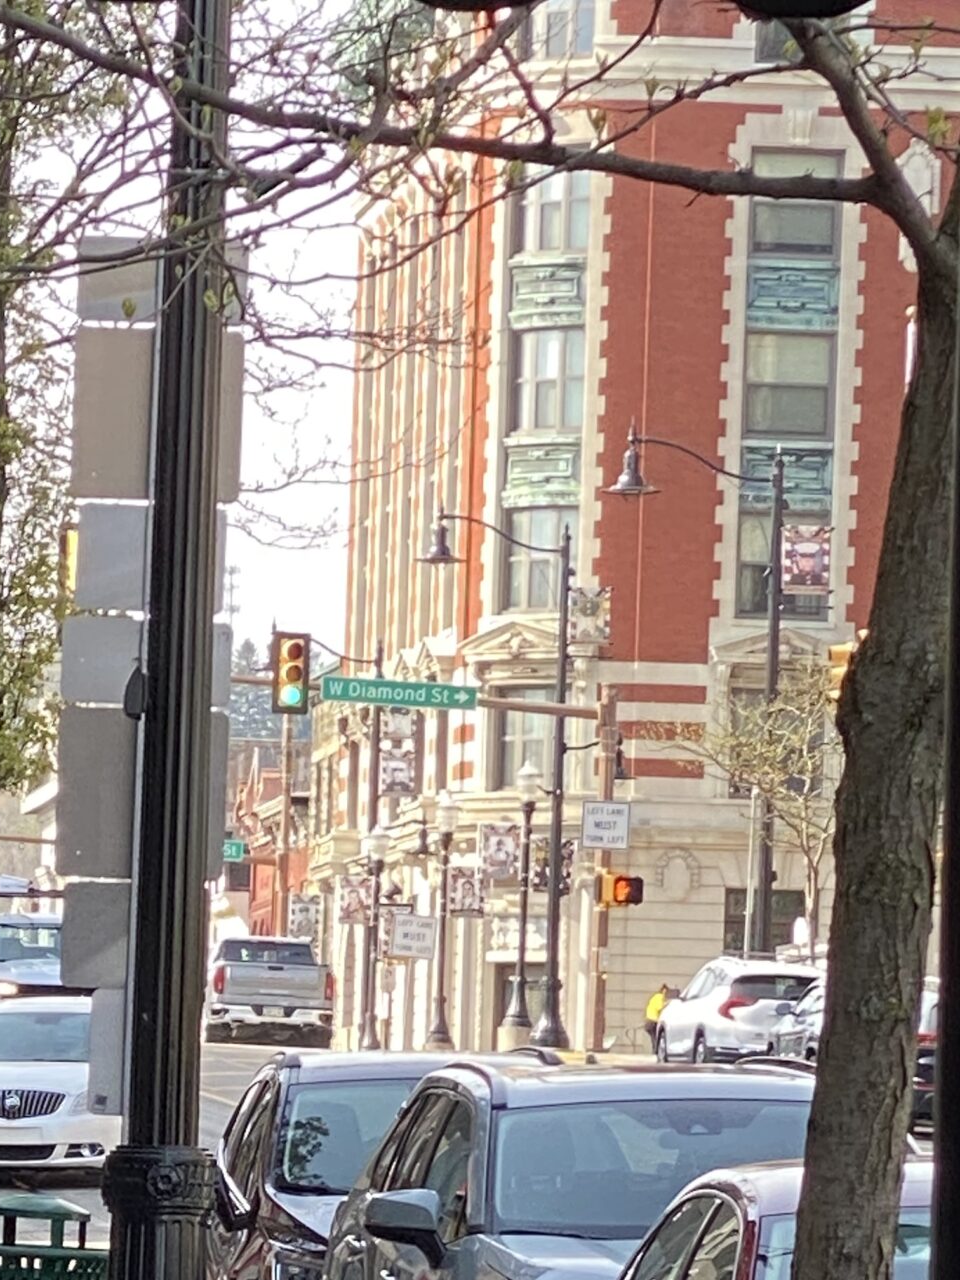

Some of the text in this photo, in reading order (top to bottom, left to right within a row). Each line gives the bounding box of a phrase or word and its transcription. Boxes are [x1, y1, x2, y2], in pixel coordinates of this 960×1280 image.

[329, 680, 449, 704] W Diamond St
[594, 820, 617, 831] MUST
